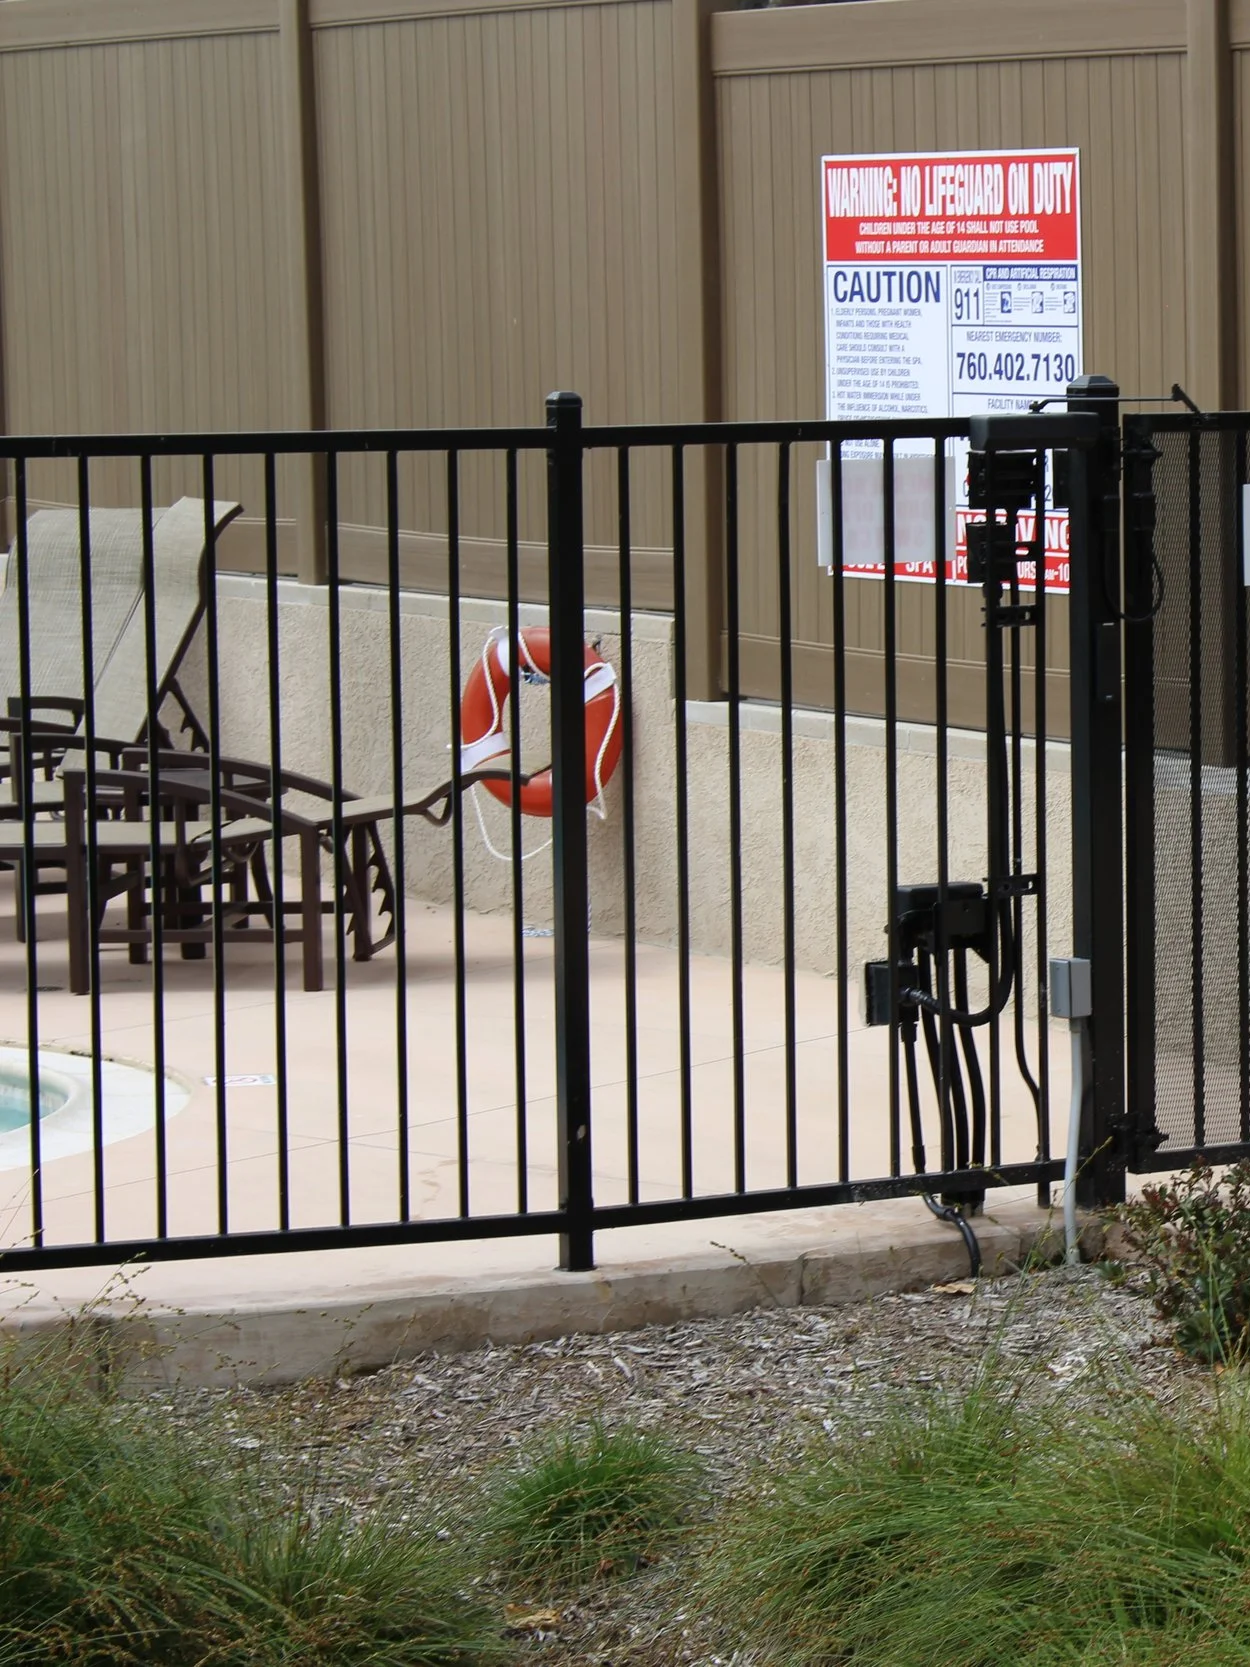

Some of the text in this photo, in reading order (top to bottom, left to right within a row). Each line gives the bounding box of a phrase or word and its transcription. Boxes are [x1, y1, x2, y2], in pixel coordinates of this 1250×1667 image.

[827, 162, 1073, 216] WARNING: NO LIFEGUARD ON DUTY
[859, 220, 1039, 235] CHILDREN UNDER THE AGE OF 14 SHALL NOT USE POOL
[855, 240, 1044, 254] WITHOUT A PARENT OR ADULT GUARDIAN IN ATTENDANCE
[985, 268, 997, 279] CPR
[998, 268, 1009, 279] AND
[1010, 268, 1039, 279] ARTIFICIAL
[1039, 268, 1076, 279] RESPIRATION
[833, 270, 941, 304] CAUTION
[954, 288, 980, 321] 911
[967, 331, 1062, 343] NEAREST EMERGENCY NUMBER:
[957, 352, 1075, 383] 760.402.7130
[988, 398, 1013, 410] FACILITY
